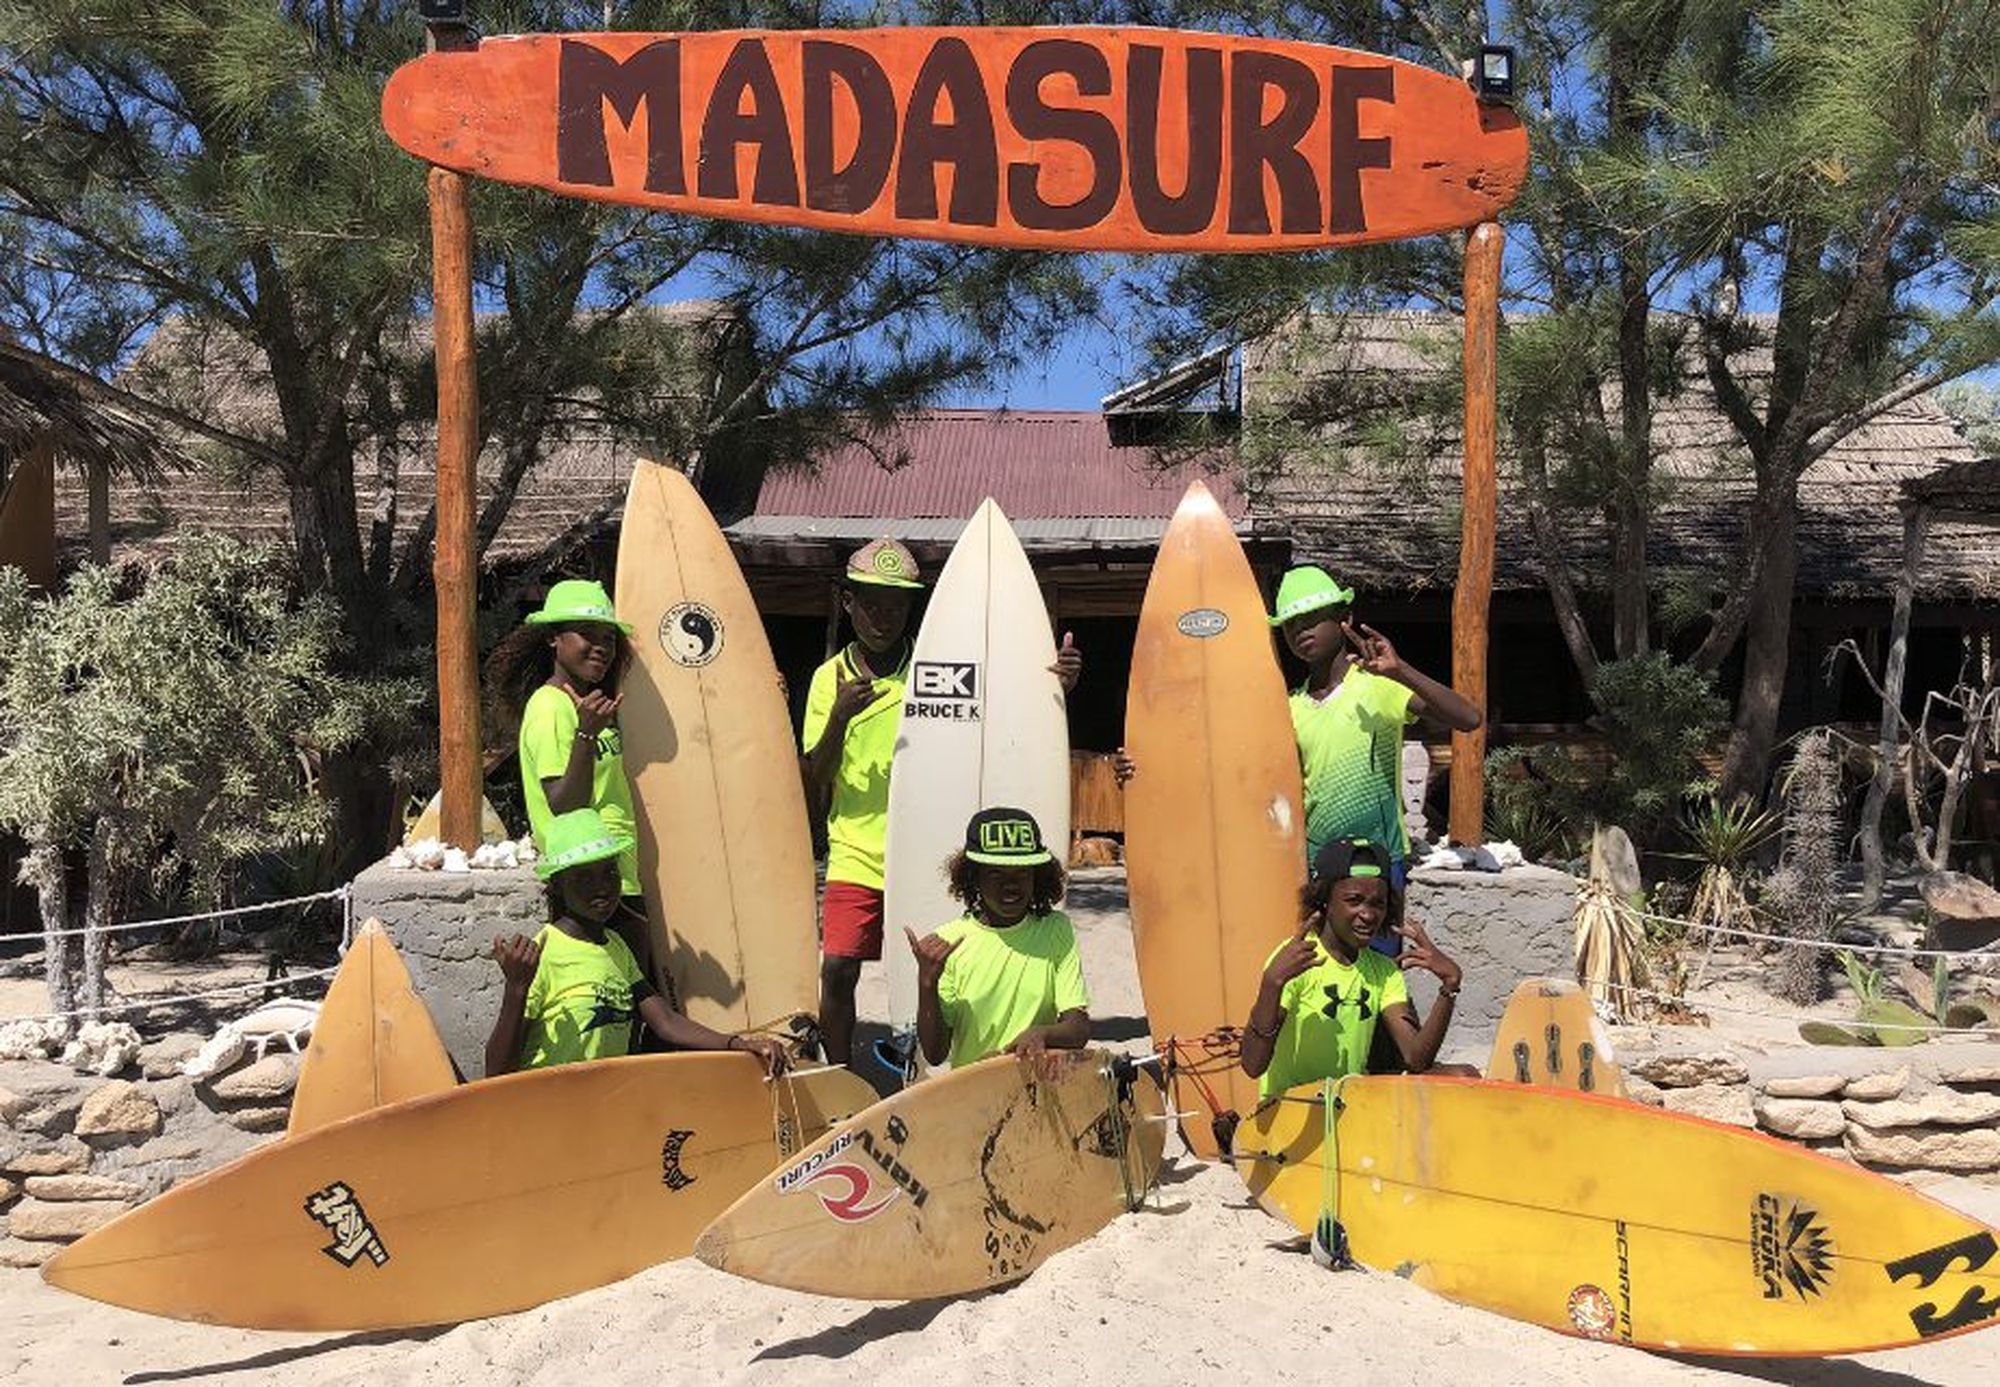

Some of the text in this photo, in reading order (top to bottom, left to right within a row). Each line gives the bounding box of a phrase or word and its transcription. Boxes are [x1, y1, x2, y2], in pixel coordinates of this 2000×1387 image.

[557, 36, 1396, 236] MADASURF
[916, 665, 973, 696] BK
[904, 702, 981, 719] BRUCE K
[981, 821, 1035, 852] LIVE
[824, 1132, 853, 1161] RIP
[777, 1152, 824, 1190] CURL
